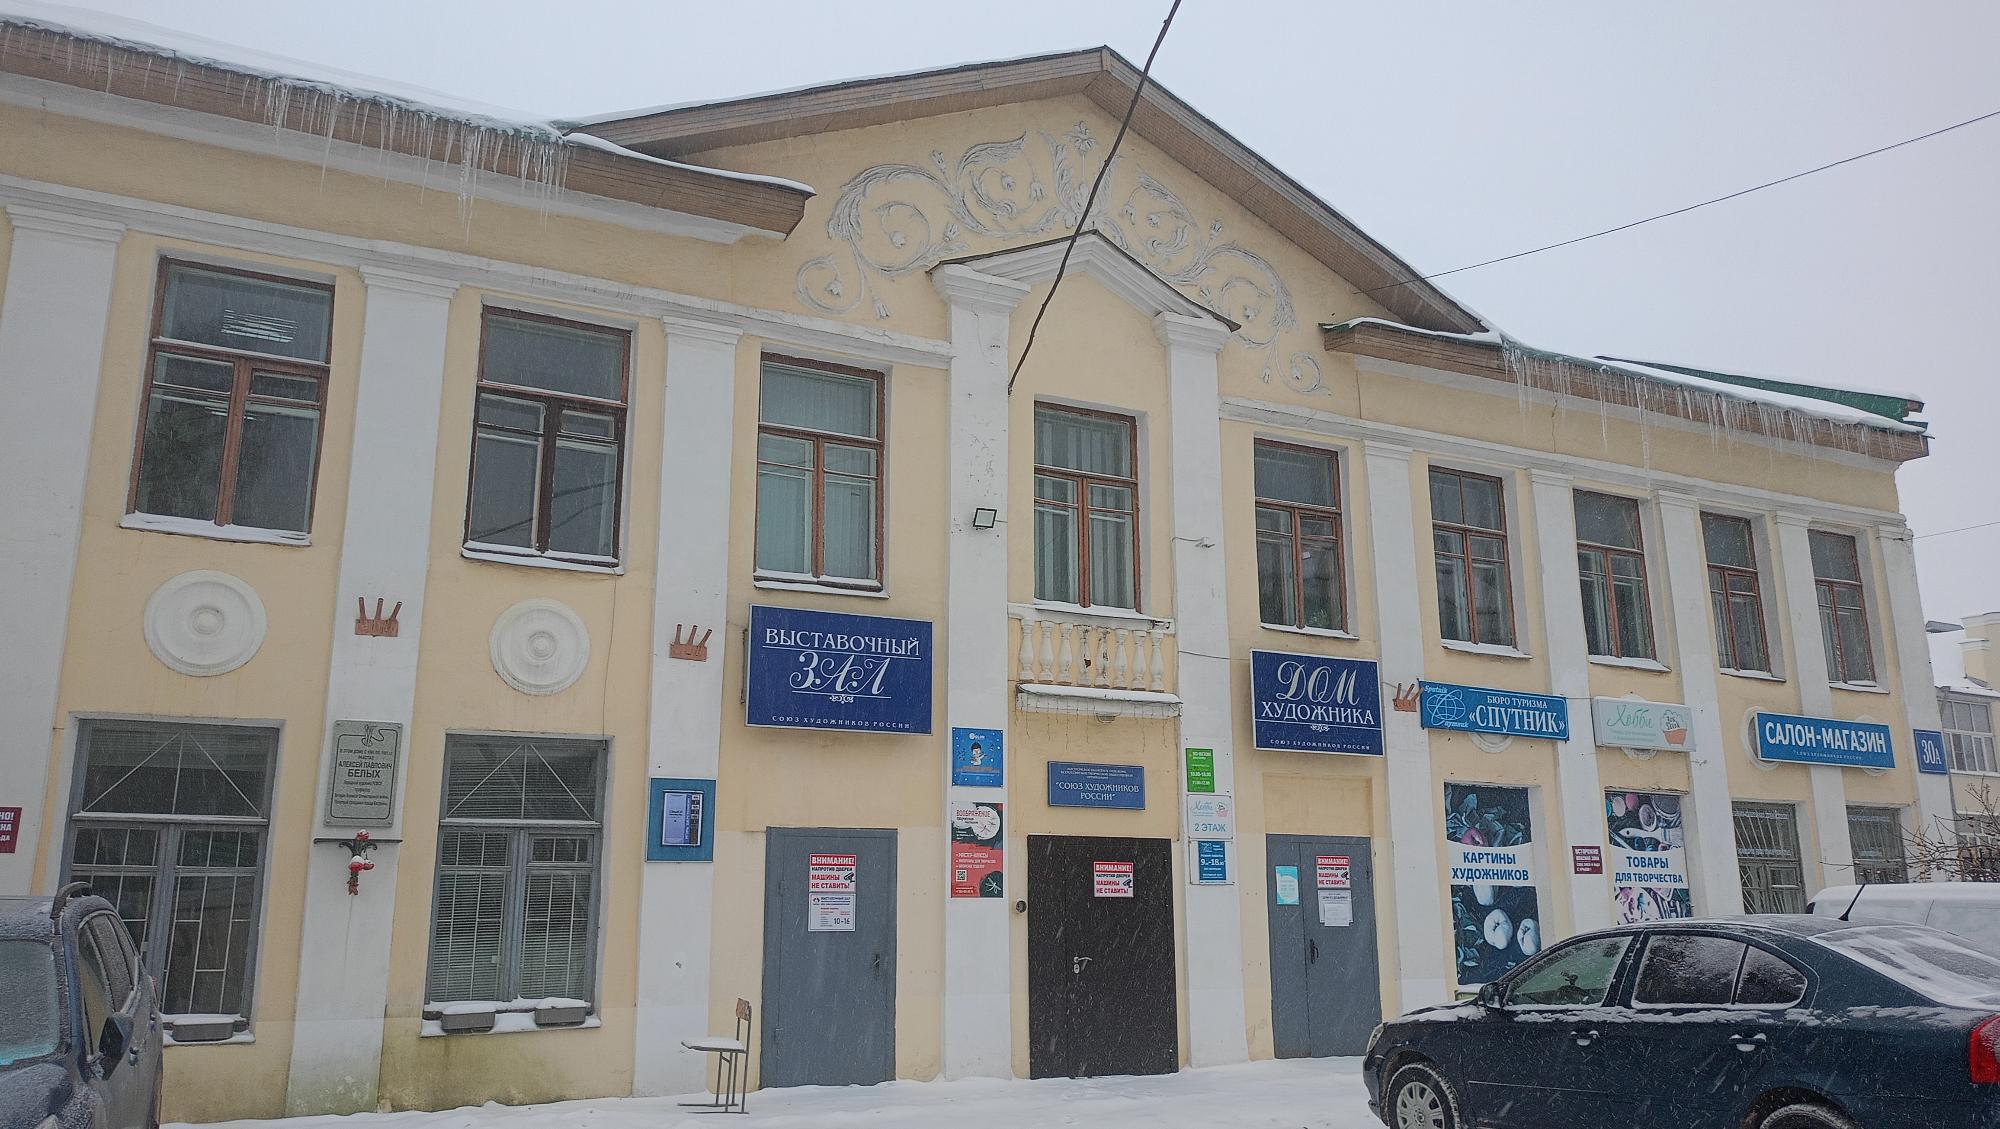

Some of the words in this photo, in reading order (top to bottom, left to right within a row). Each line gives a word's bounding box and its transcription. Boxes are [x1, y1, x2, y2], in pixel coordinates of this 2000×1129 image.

[765, 628, 919, 656] ВЫСТАВОЧНЫЙ
[790, 651, 890, 695] ЗАЛ
[1276, 661, 1360, 705] ДОМ
[1487, 696, 1510, 705] БЮРО
[1512, 698, 1548, 708] ТУРИЗМА
[1262, 702, 1374, 724] ХУДОЖНИКА
[1469, 705, 1565, 733] «СПУТНИК»
[1607, 704, 1654, 728] Хобби
[804, 718, 869, 727] ХУДОЖНИКОВ
[873, 721, 910, 729] РОССИИ
[1765, 722, 1886, 753] САЛОН-МАГАЗИН
[339, 760, 363, 768] АЛЕКСЕЙ
[348, 769, 380, 778] БЕЛЫХ
[1085, 783, 1140, 792] ХУДОЖНИКОВ
[1194, 823, 1200, 831] 2
[1202, 823, 1226, 832] ЭТАЖ
[1463, 852, 1516, 865] КАРТИНЫ
[1626, 856, 1668, 869] ТОВАРЫ
[1452, 868, 1529, 881] ХУДОЖНИКОВ
[1615, 873, 1632, 883] ДЛЯ
[1633, 873, 1683, 883] ТВОРЧЕСТВА
